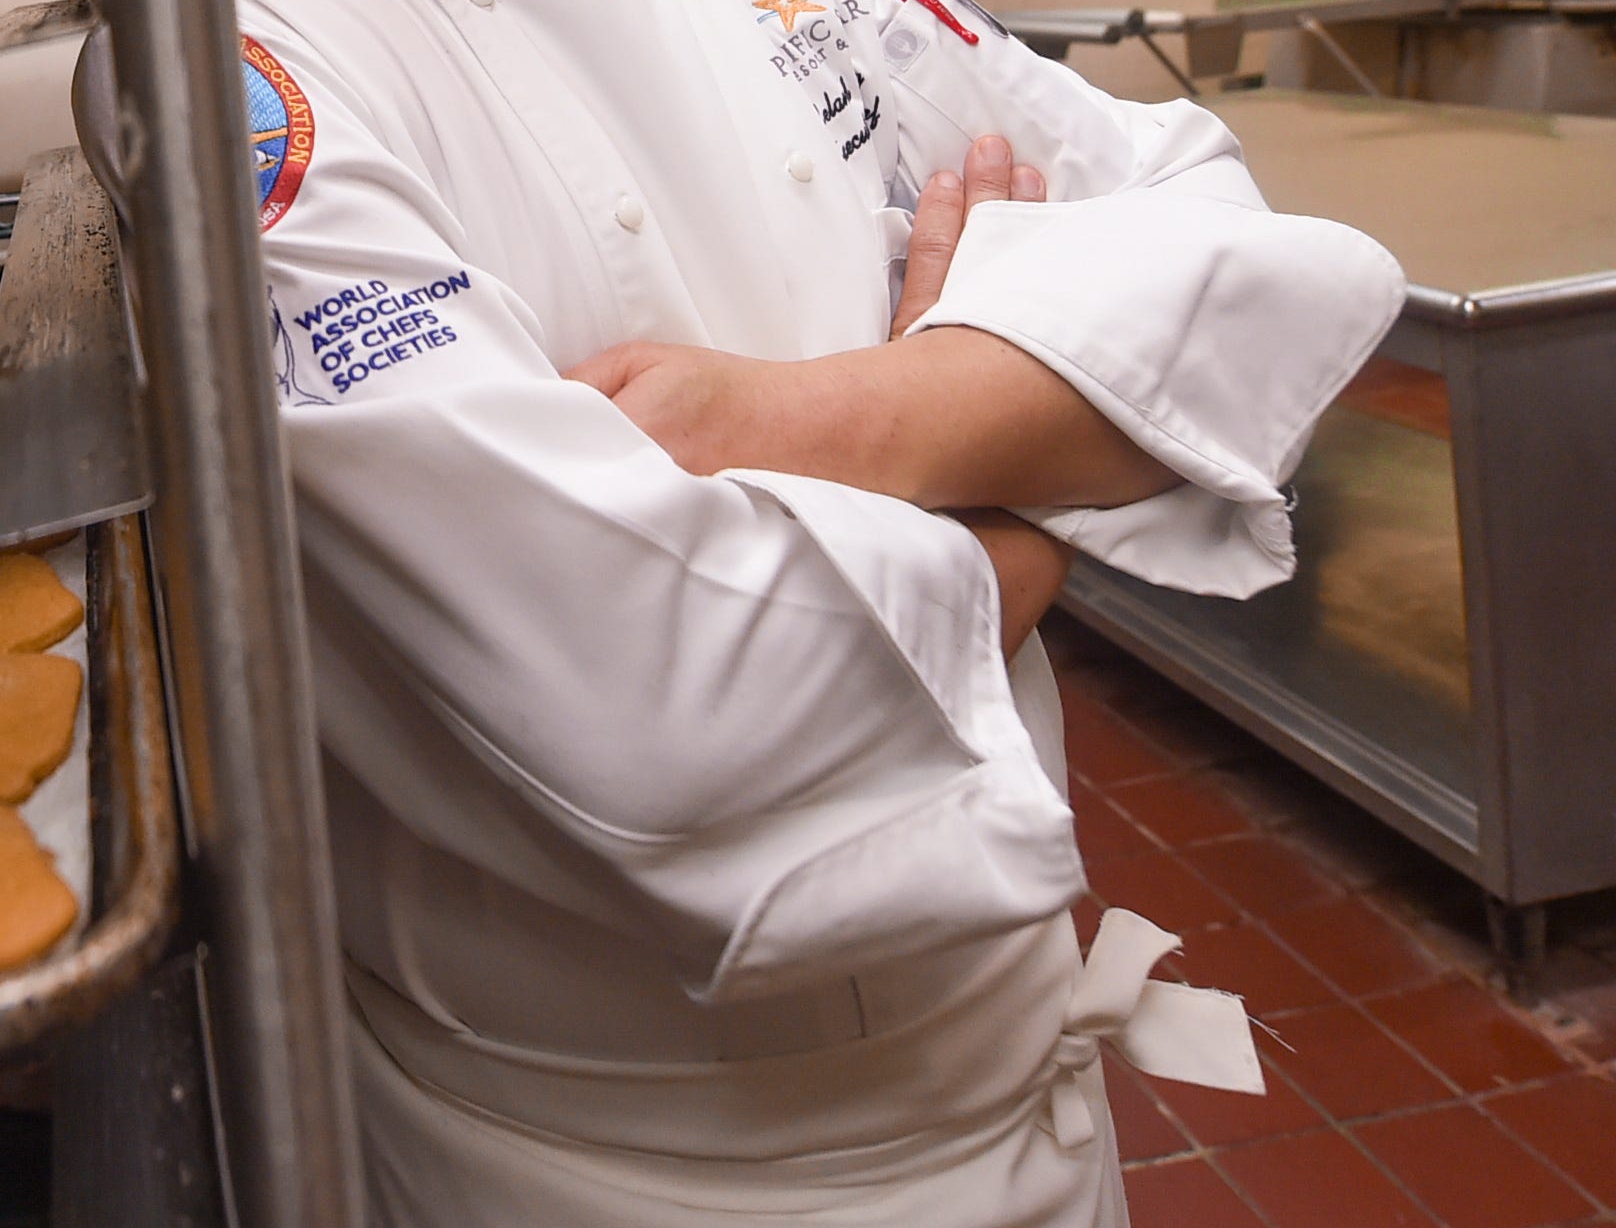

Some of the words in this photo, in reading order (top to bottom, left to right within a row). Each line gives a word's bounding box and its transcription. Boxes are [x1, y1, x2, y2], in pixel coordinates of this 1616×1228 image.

[293, 279, 389, 331] WORLD
[311, 270, 471, 354] ASSOCIATION
[320, 340, 355, 372] OF
[361, 308, 439, 348] CHEFS
[332, 325, 457, 394] SOCIETIES
